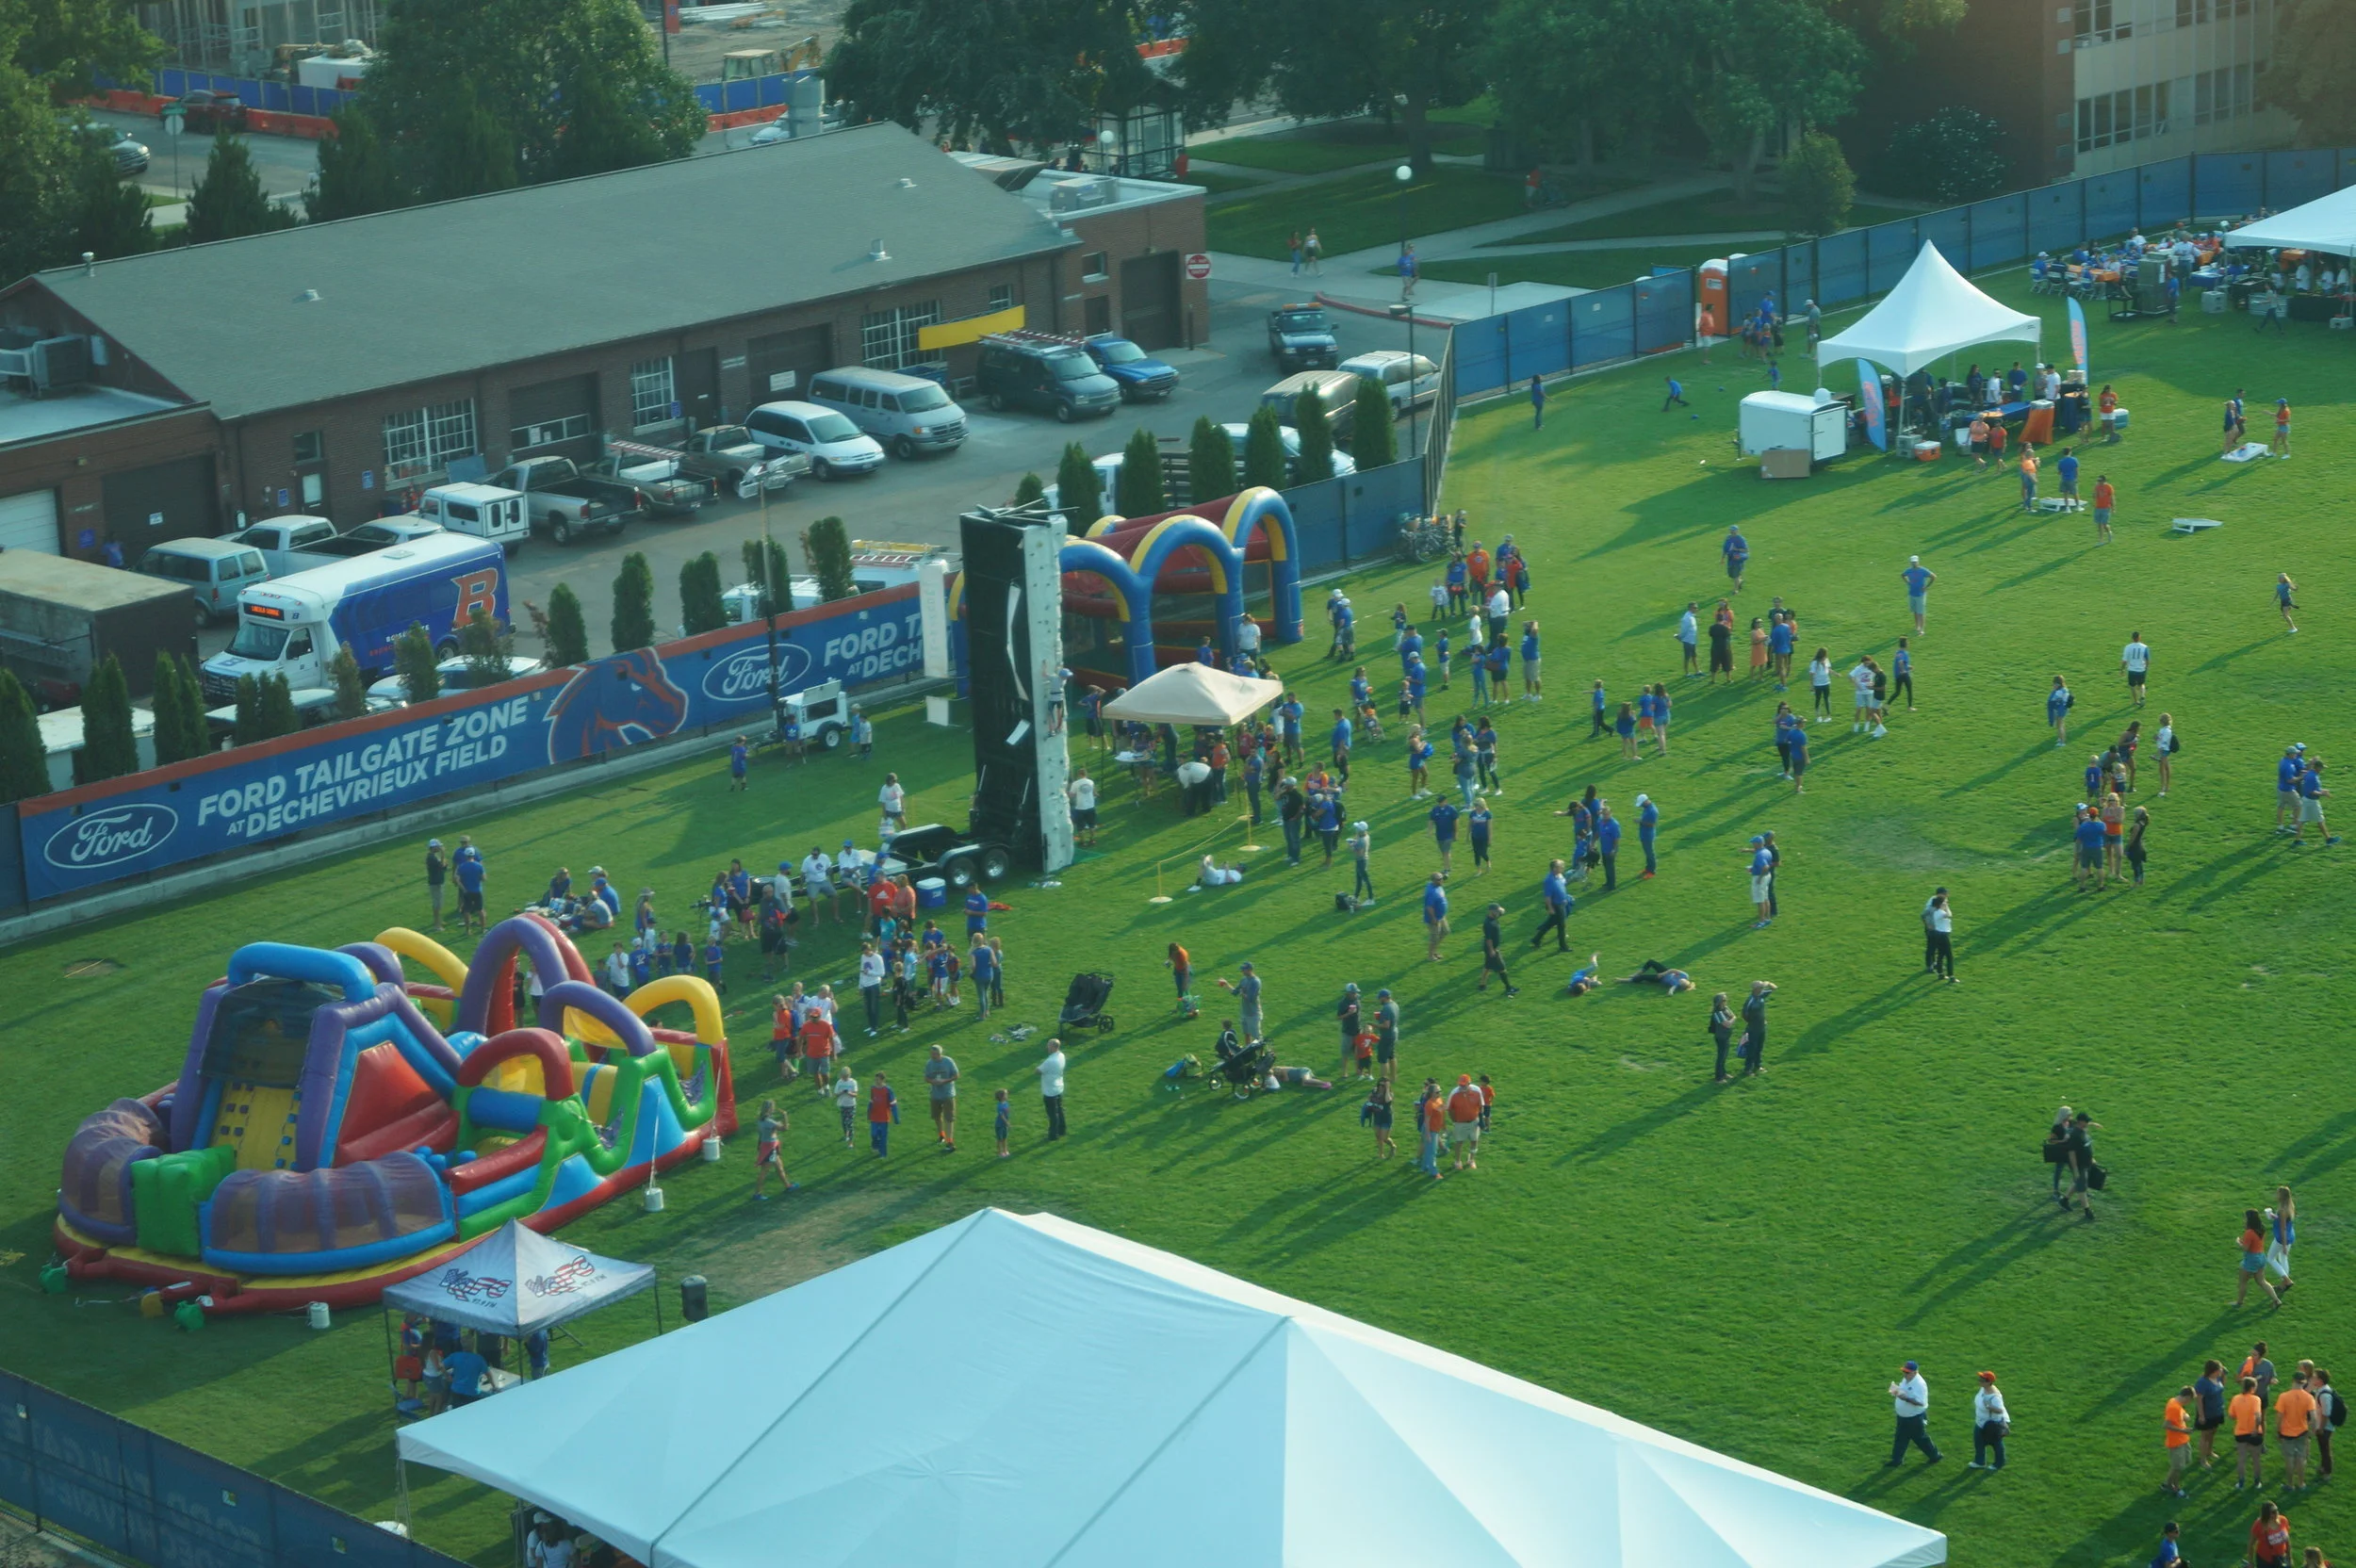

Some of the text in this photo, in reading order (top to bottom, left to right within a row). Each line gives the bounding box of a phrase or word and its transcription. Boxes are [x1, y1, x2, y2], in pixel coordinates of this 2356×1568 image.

[450, 567, 499, 631] B
[823, 622, 897, 666] FORD
[2133, 648, 2141, 659] 11
[847, 661, 863, 676] AT
[198, 695, 529, 826] FORD TAILGATE ZONE
[226, 735, 507, 838] AT DECHEVRIEUX FIELD
[71, 813, 153, 861] Ford
